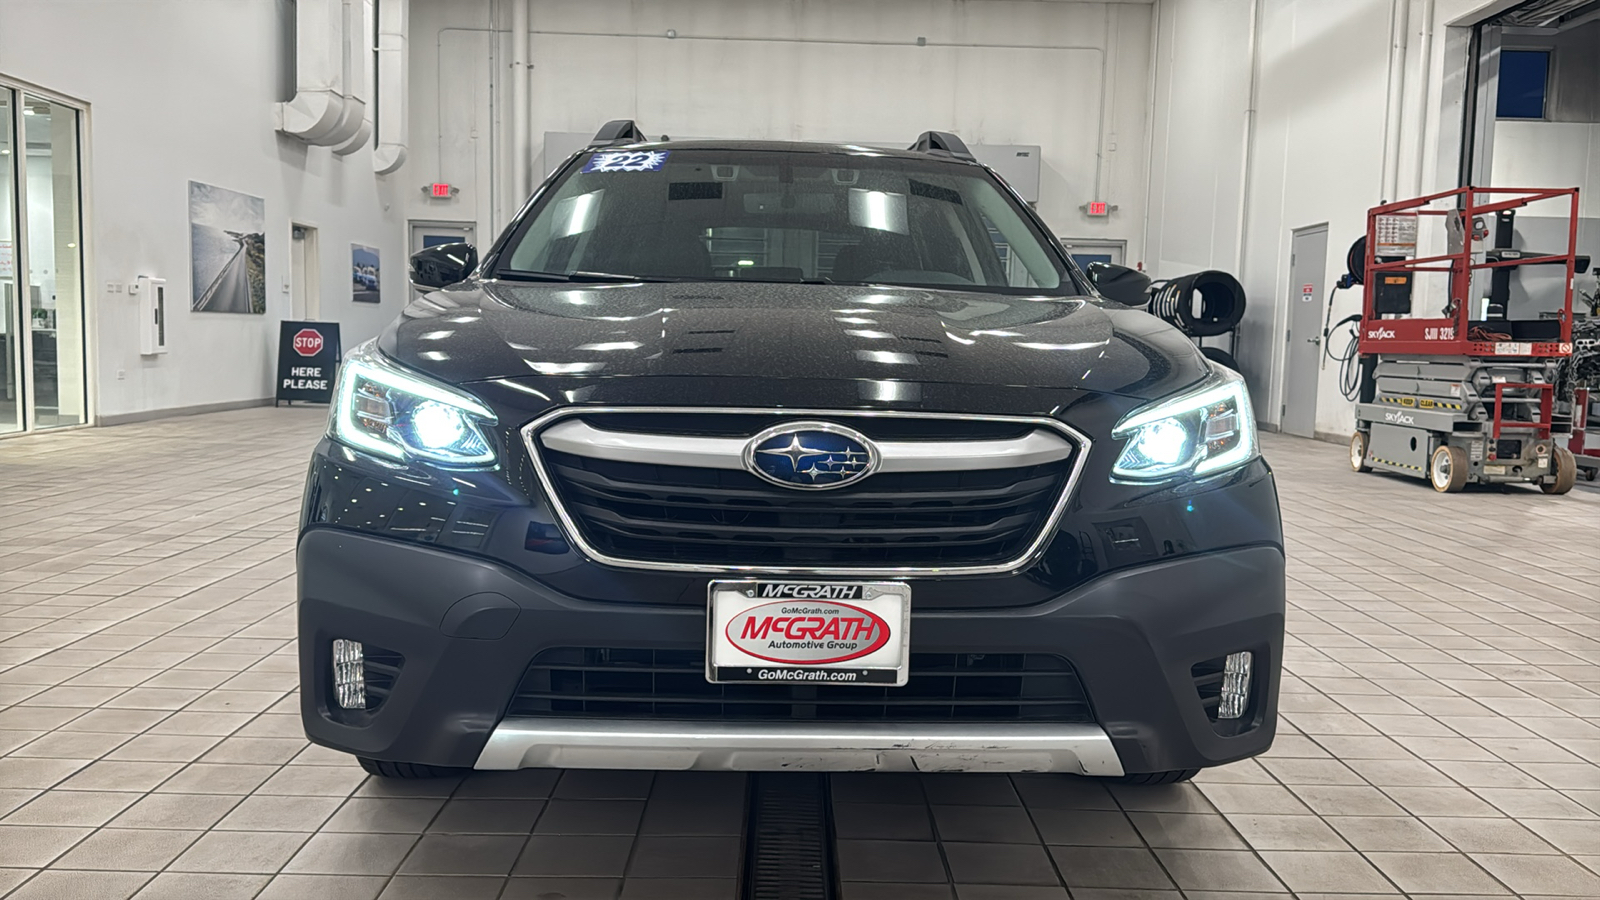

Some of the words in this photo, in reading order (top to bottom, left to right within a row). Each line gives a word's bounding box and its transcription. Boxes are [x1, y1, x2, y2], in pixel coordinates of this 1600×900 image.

[605, 155, 650, 167] 22
[433, 183, 449, 196] EXIT
[1090, 202, 1106, 214] EXIT
[1368, 327, 1396, 340] SKYJACK
[295, 337, 321, 348] STOP
[291, 366, 322, 377] HERE
[283, 379, 328, 390] PLEASE
[1385, 411, 1415, 424] SKYJACK
[781, 607, 839, 615] GoMcGrath.com
[768, 640, 825, 649] Automotive
[826, 641, 858, 651] Group
[757, 669, 857, 681] GoMcGrath.com
